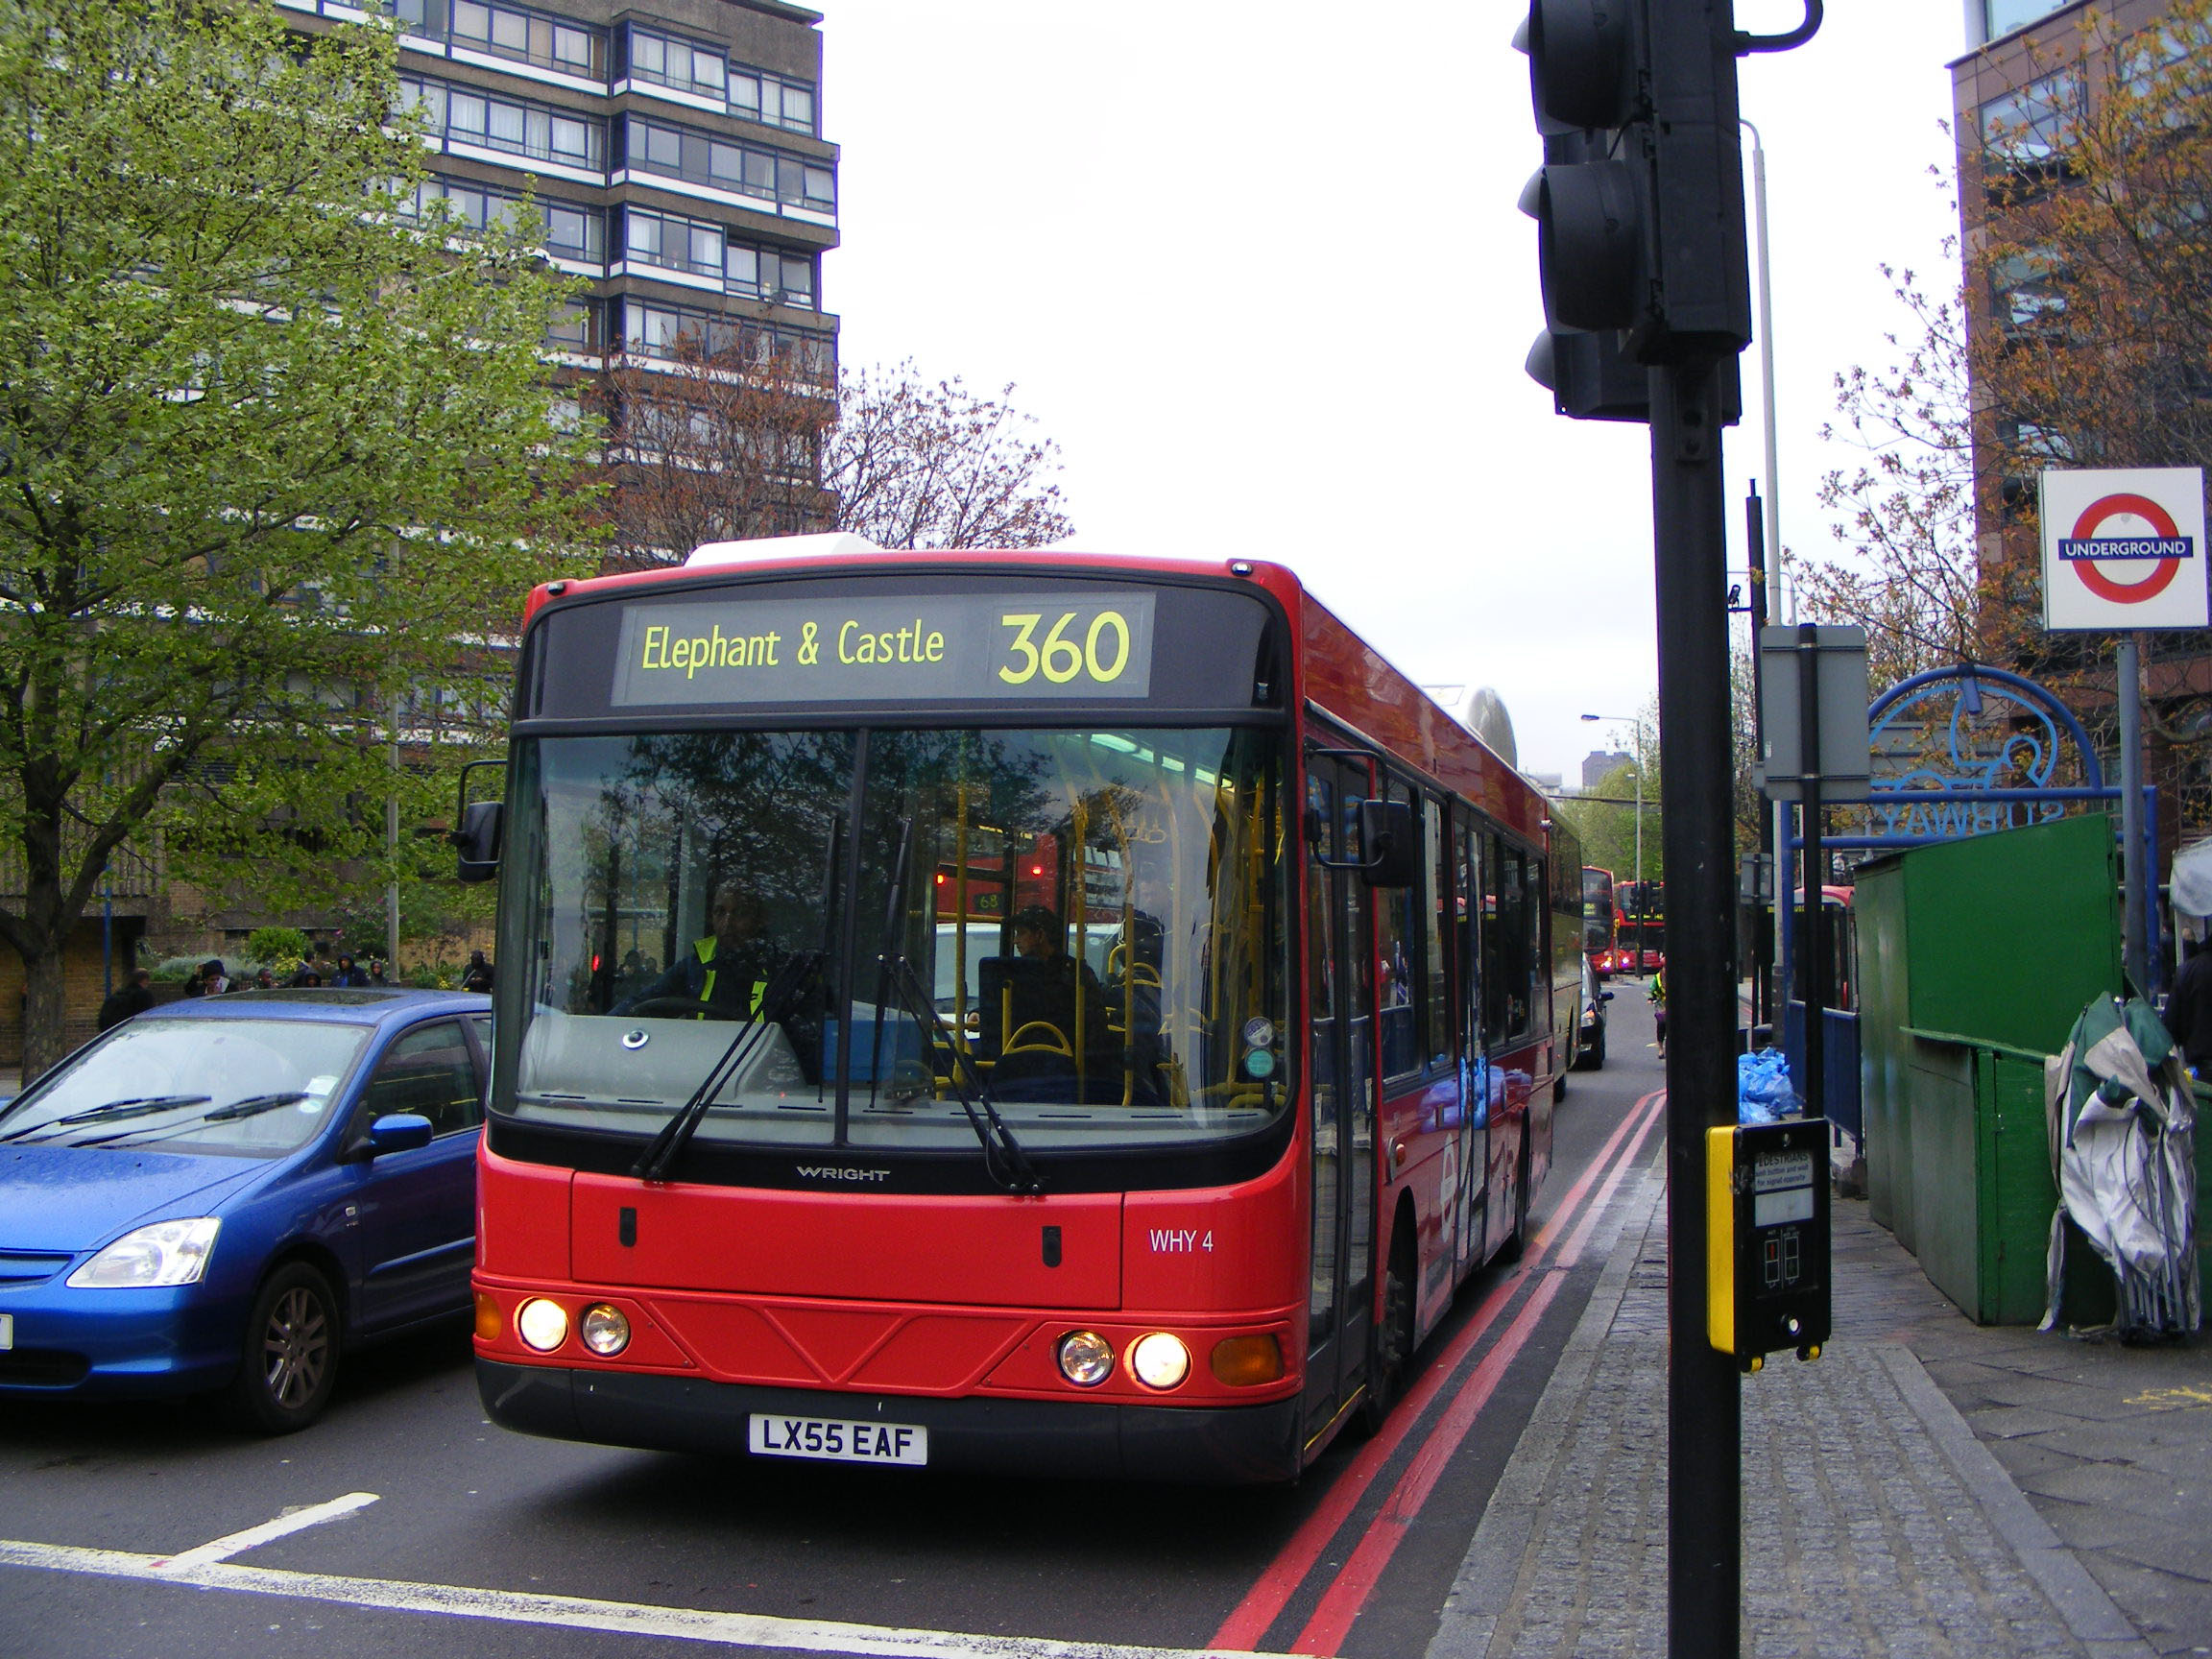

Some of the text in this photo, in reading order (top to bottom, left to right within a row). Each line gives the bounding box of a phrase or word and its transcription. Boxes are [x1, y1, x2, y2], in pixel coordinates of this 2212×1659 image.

[2065, 541, 2186, 556] UNDERGROUND
[642, 619, 944, 680] Elephant & Castle
[998, 611, 1130, 685] 360
[979, 895, 998, 908] 68
[796, 1166, 891, 1182] WRIGHT
[1150, 1229, 1214, 1252] WHY 4
[763, 1420, 913, 1457] LX55 EAF
